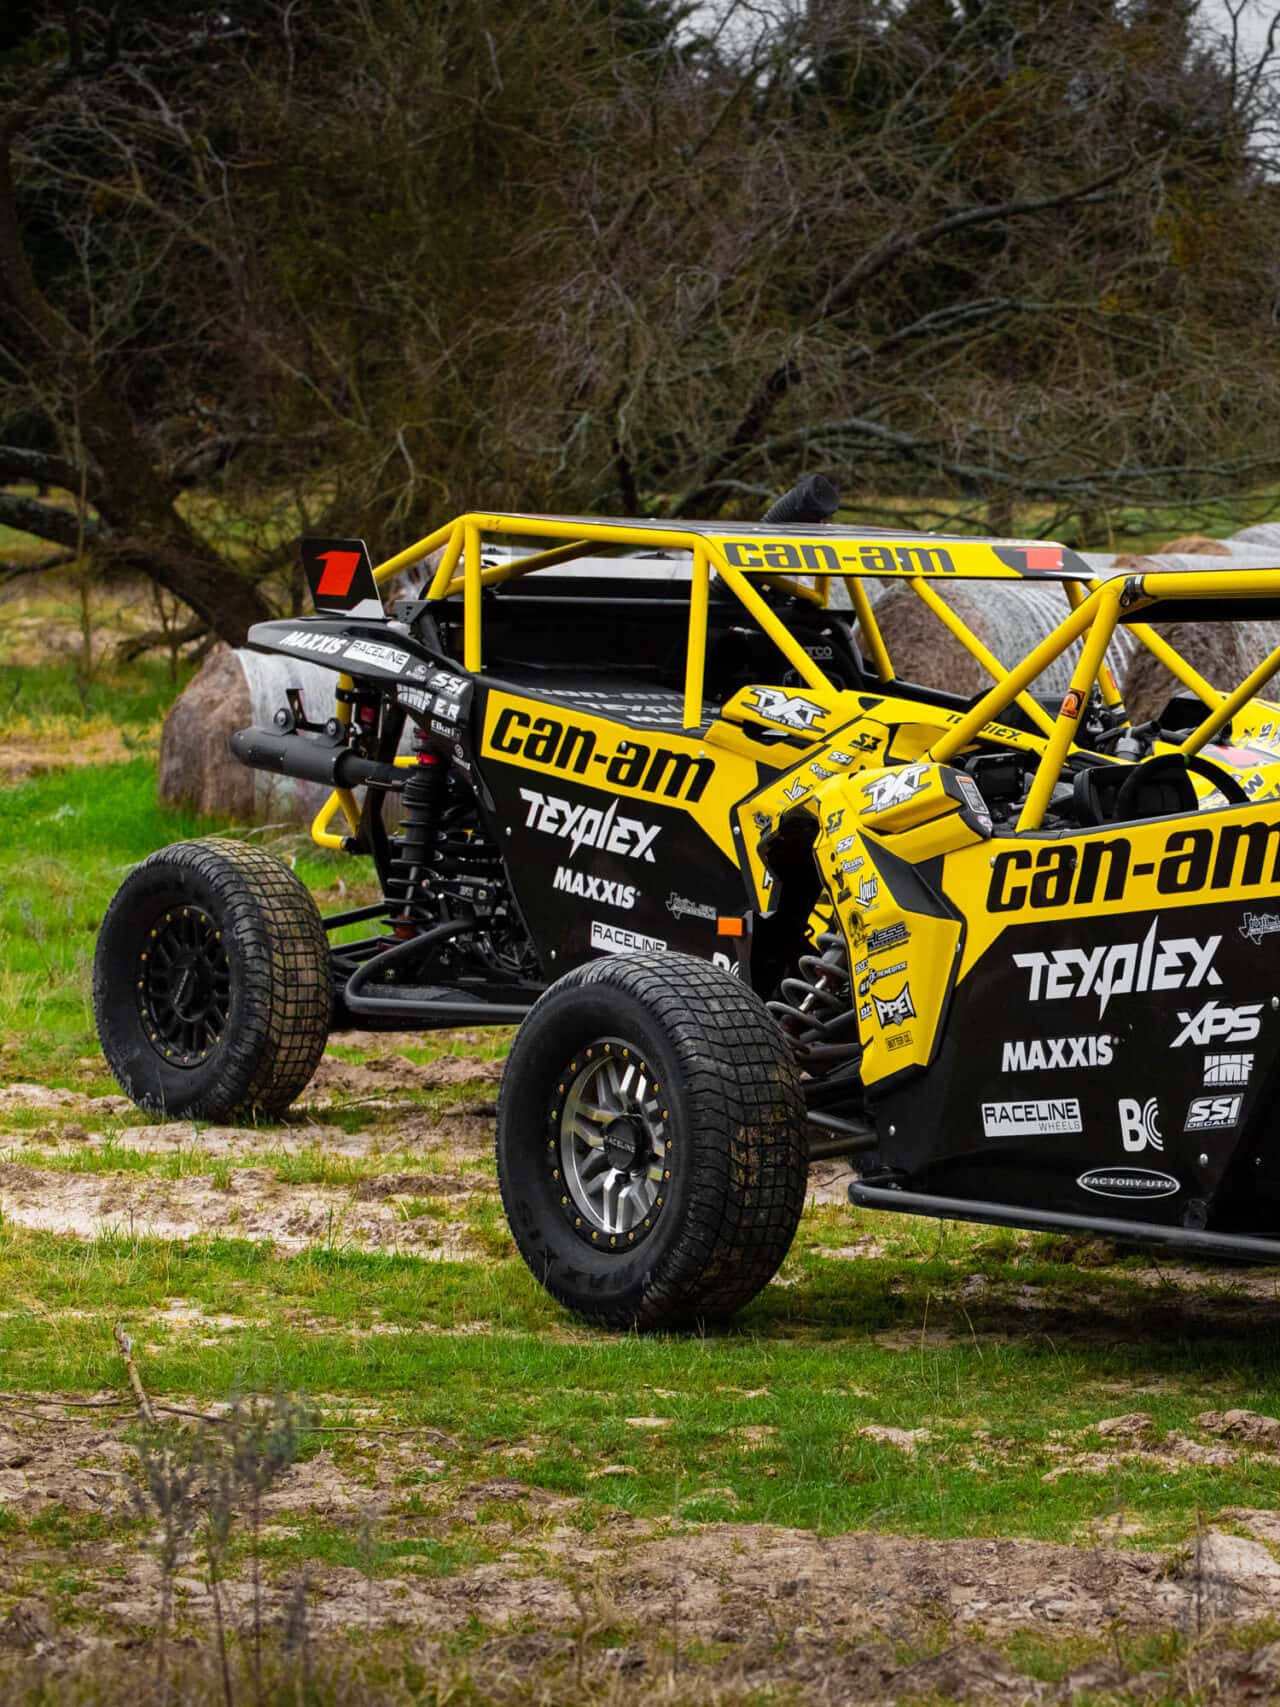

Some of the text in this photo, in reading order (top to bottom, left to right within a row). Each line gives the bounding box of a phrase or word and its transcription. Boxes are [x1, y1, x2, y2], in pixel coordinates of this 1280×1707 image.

[723, 542, 956, 573] can-am
[315, 551, 362, 597] 1
[280, 631, 348, 655] MAXXIS
[351, 641, 408, 666] RACELINE
[490, 707, 716, 804] can-am
[552, 866, 637, 910] MAXXIS
[593, 925, 665, 952] RACELINE
[1169, 1001, 1265, 1048] XPS
[1001, 1035, 1114, 1073] MAXXIS
[1204, 1054, 1254, 1081] HMF
[984, 1102, 1079, 1124] RACELINE
[1187, 1118, 1236, 1129] DECALS
[1188, 1097, 1241, 1123] SSI
[1039, 1121, 1081, 1132] WHEELS
[1083, 1176, 1173, 1189] FACTORY UTV
